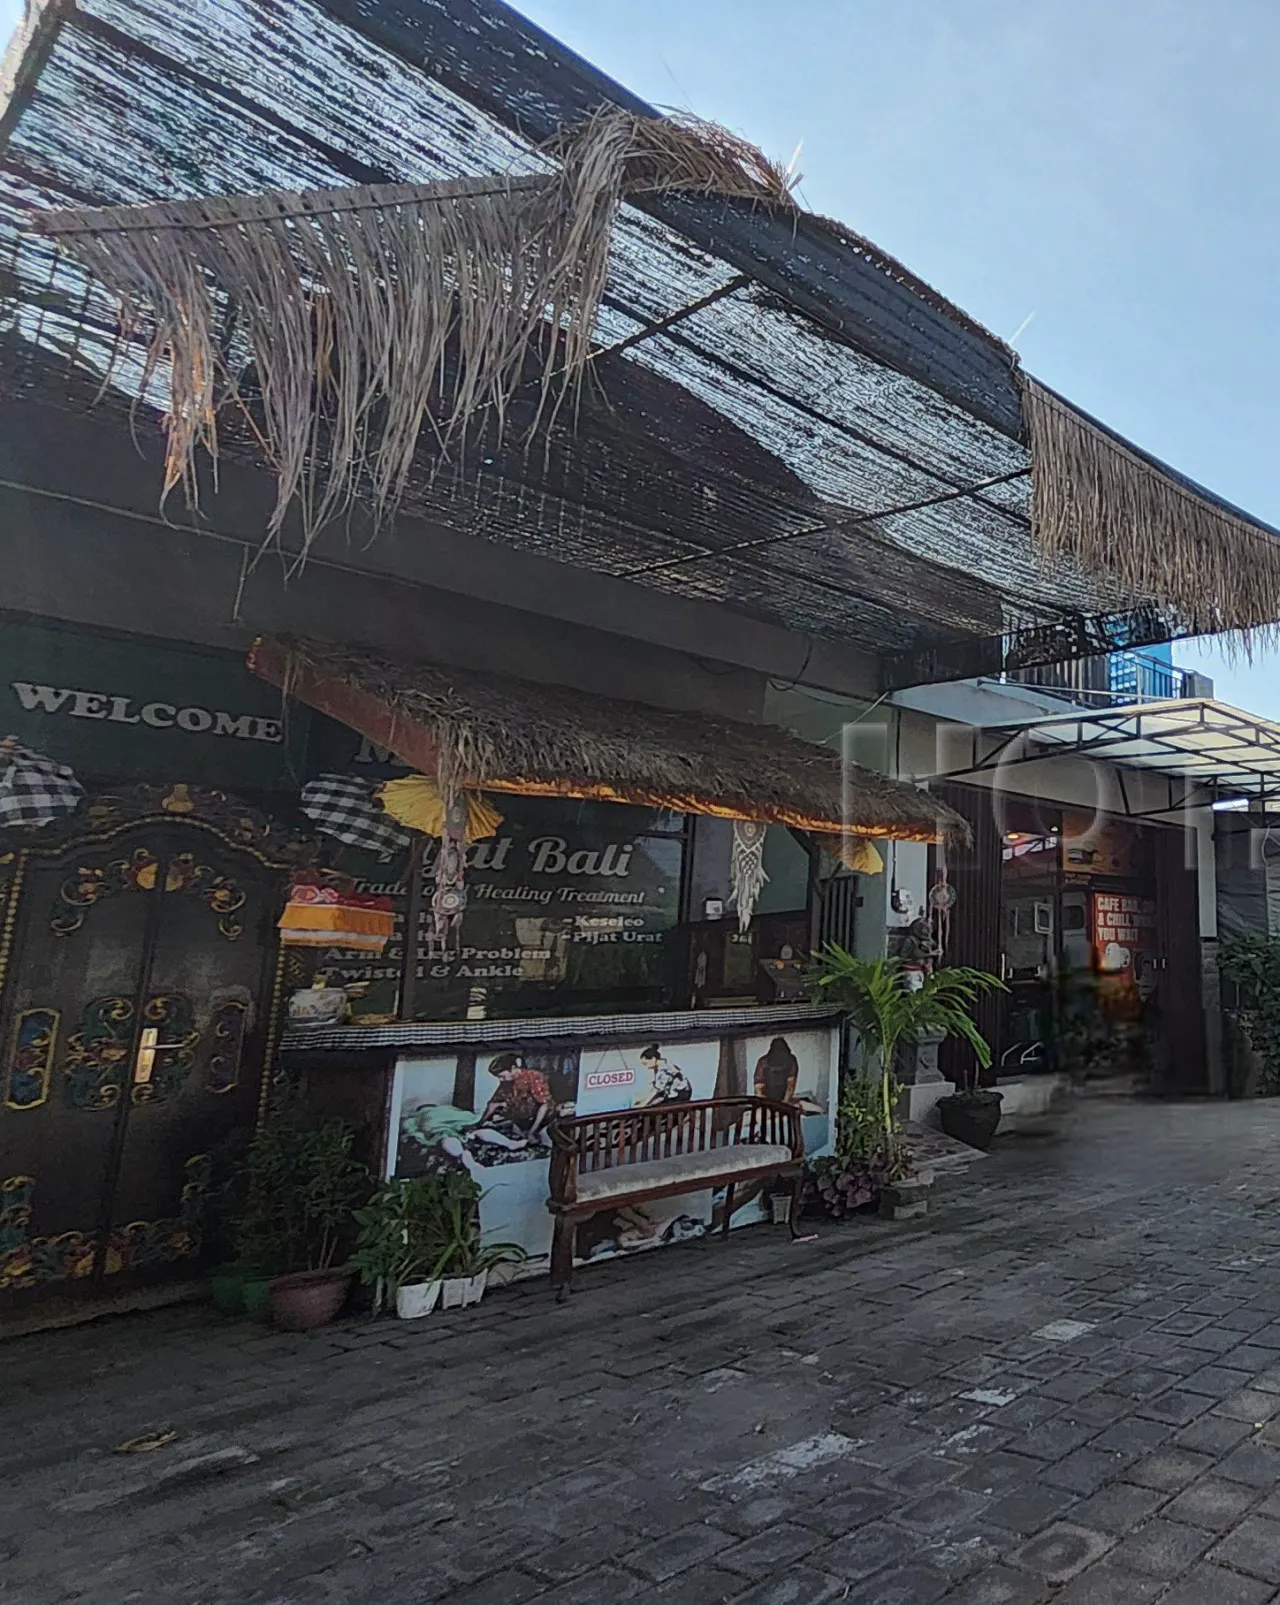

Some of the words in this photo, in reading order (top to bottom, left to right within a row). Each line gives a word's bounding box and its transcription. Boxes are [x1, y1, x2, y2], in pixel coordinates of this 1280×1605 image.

[11, 682, 284, 743] WELCOME
[528, 835, 635, 877] Bali
[474, 883, 552, 905] Healing
[557, 886, 646, 905] Treatment
[1097, 896, 1120, 912] CAFE
[1106, 912, 1132, 927] CHILL
[621, 931, 664, 944] Urat
[1097, 927, 1116, 941] YOU
[461, 946, 552, 960] Problem
[430, 964, 450, 978] &
[455, 965, 525, 977] Ankle
[588, 1071, 634, 1086] CLOSED
